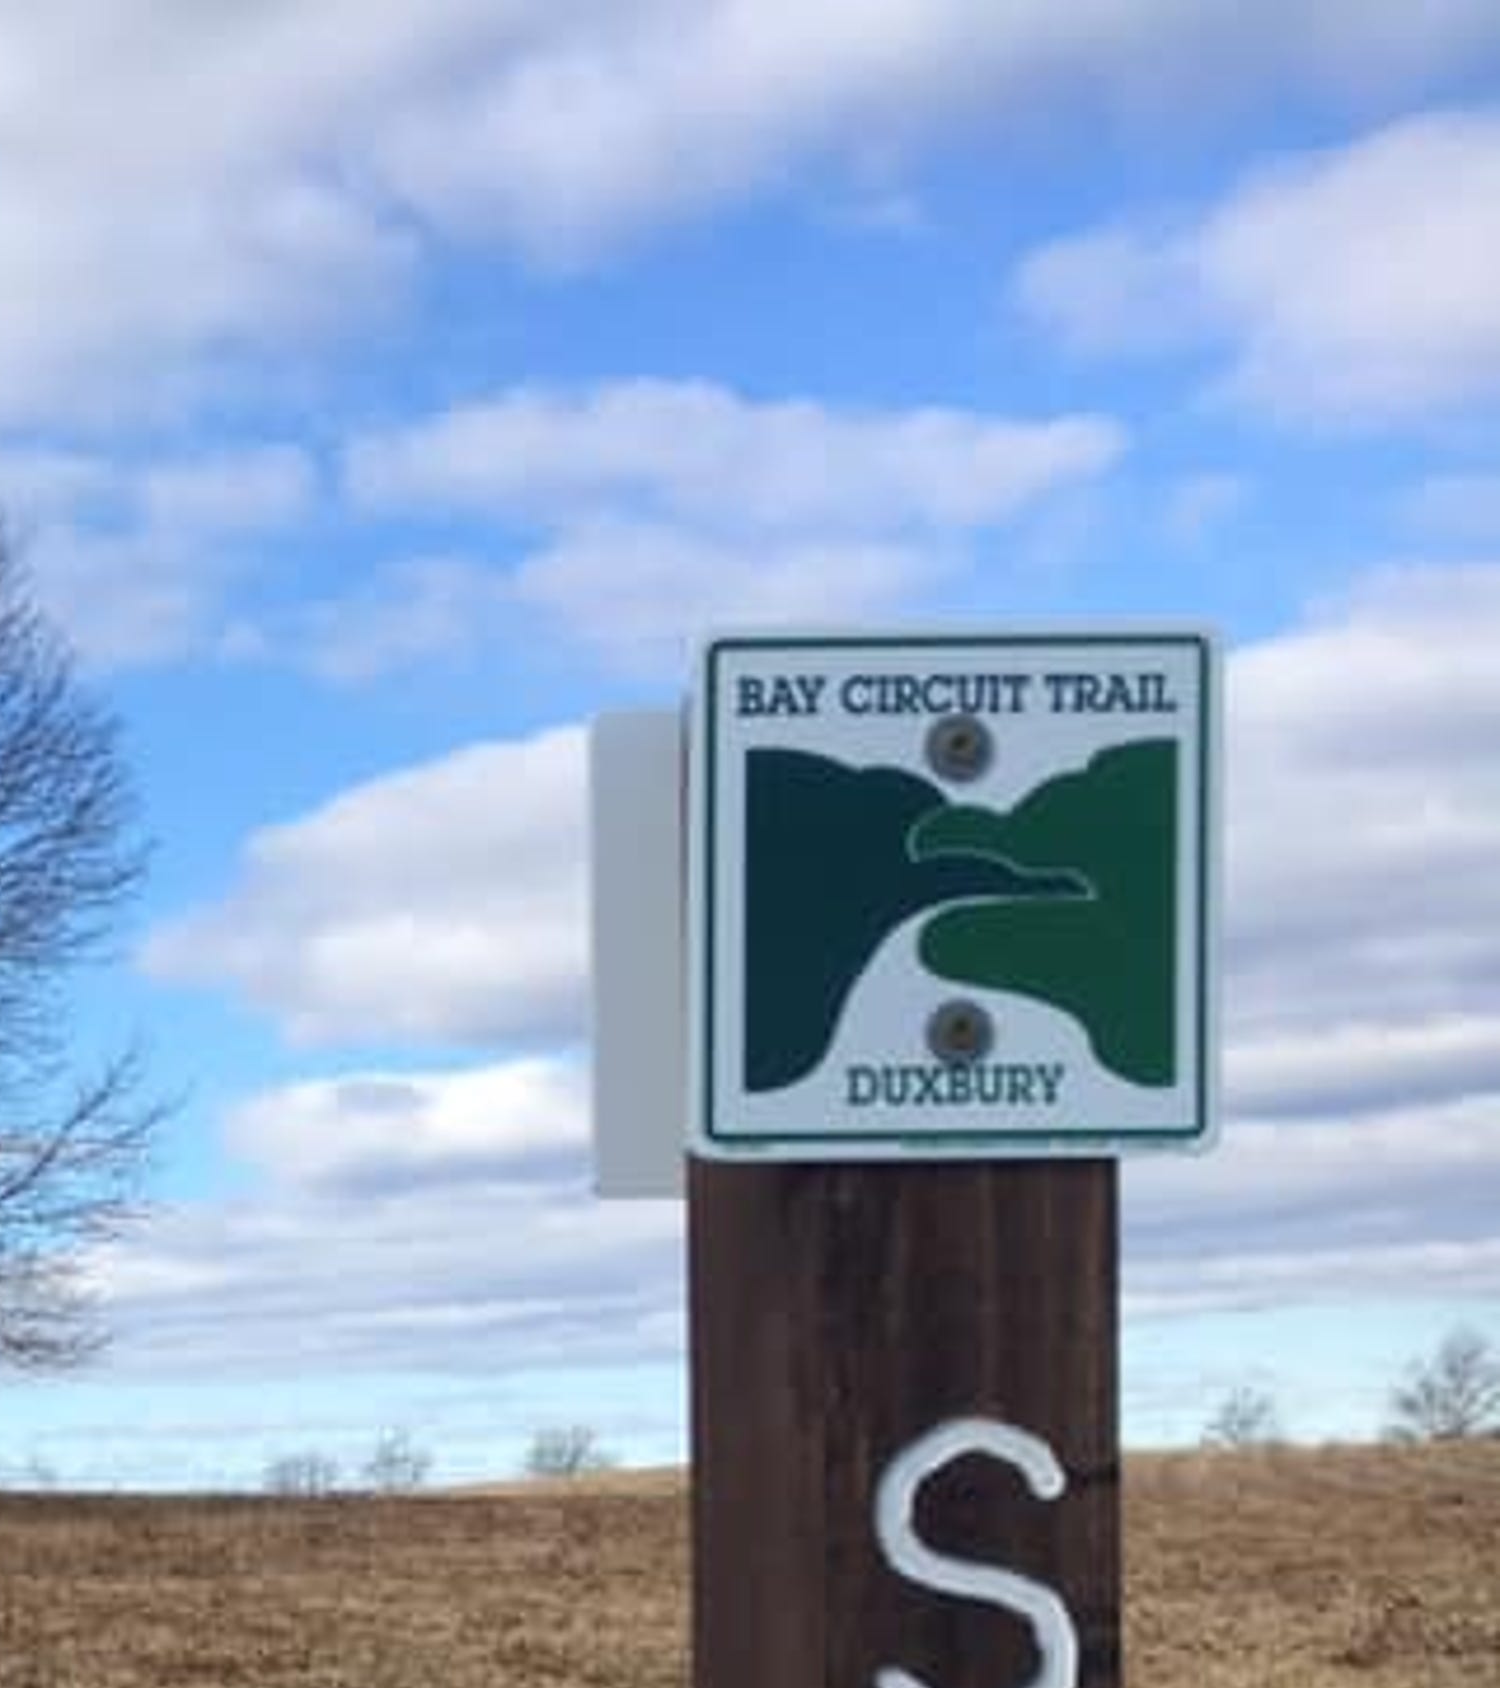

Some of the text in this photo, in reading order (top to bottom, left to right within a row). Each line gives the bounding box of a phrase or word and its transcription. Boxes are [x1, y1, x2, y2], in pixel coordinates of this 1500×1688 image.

[736, 673, 1178, 716] BAY CIRCUIT TRAIL
[847, 1064, 1064, 1106] DUXBURY
